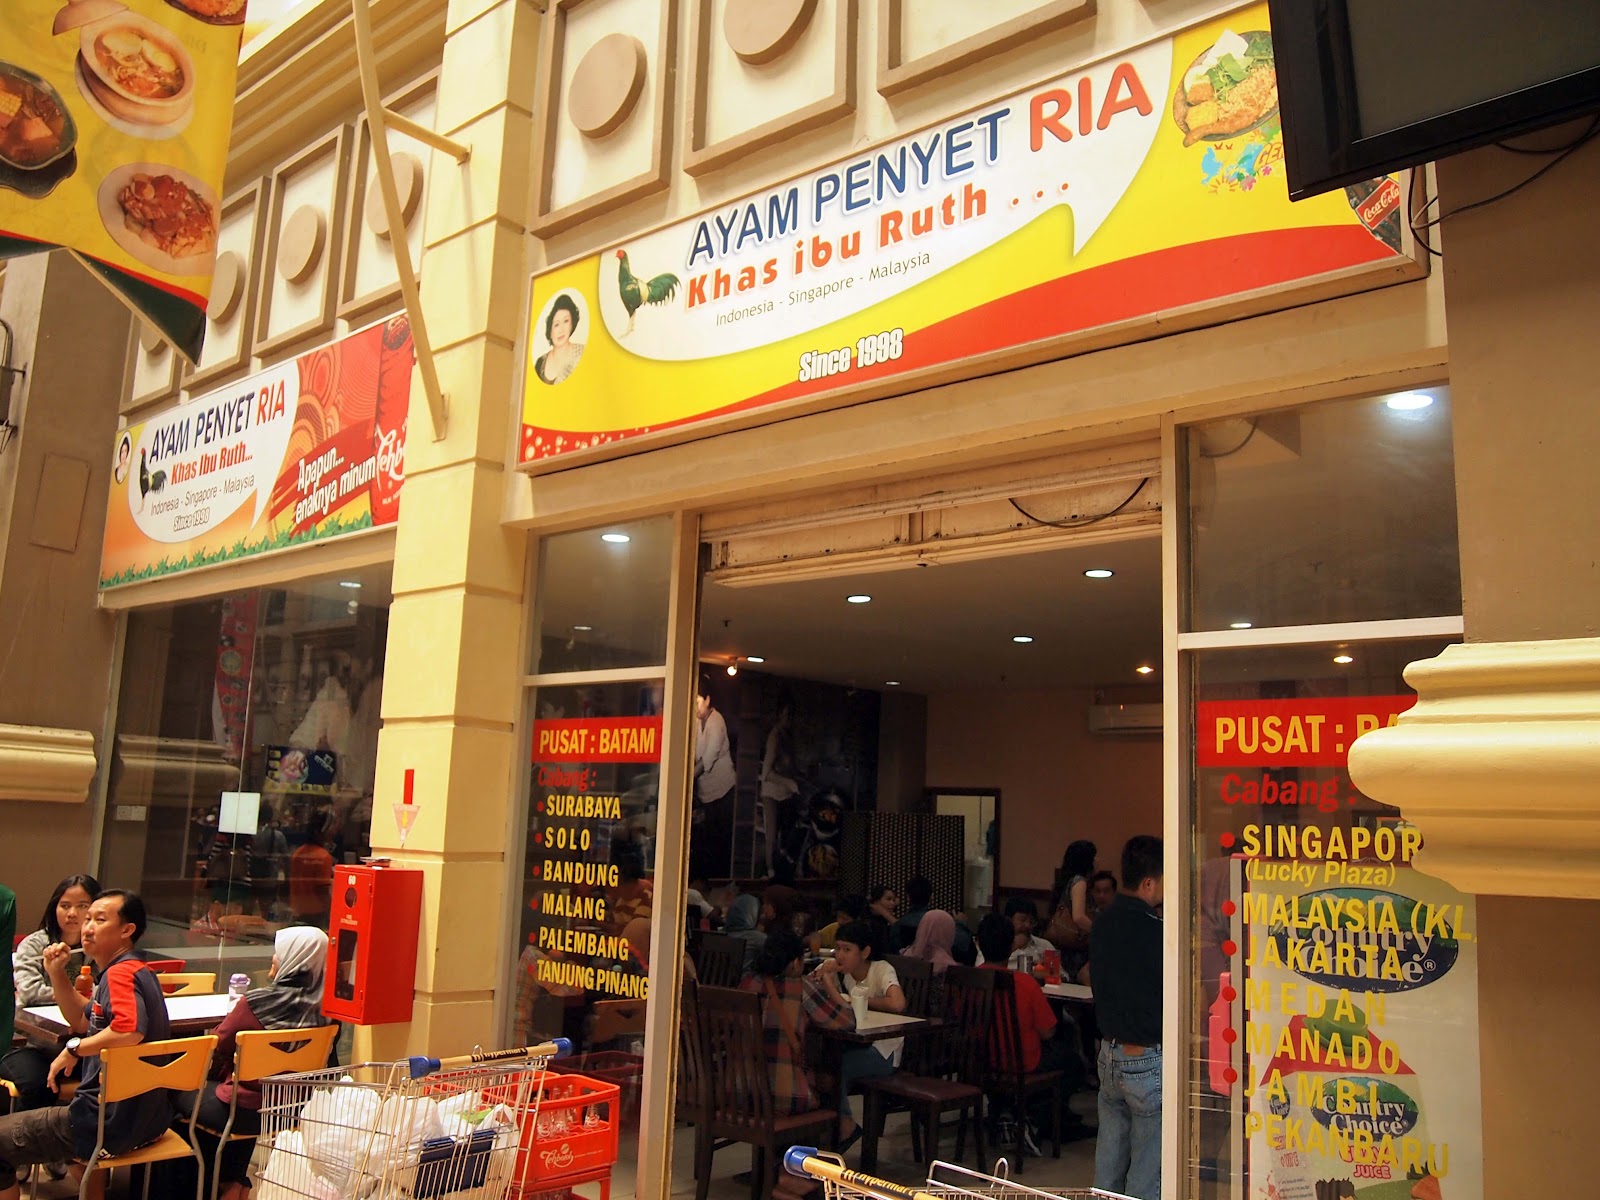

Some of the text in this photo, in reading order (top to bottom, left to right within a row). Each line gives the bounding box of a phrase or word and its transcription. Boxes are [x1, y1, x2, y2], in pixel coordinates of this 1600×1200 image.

[688, 61, 1153, 266] AYAM PENYET RIA
[1253, 142, 1284, 171] GE
[687, 257, 778, 309] Khas
[793, 229, 861, 276] ibu
[879, 182, 988, 248] Ruth
[715, 298, 775, 327] Indonesia
[787, 275, 854, 306] Singapore
[868, 251, 931, 280] Malaysia
[798, 327, 904, 382] Since 1998
[149, 379, 285, 465] AYAM PENYET RIA
[171, 459, 197, 485] Khas
[199, 452, 218, 476] Ibu
[151, 496, 179, 516] Indonesia
[184, 488, 218, 508] Singapore
[223, 474, 255, 495] Malaysia
[295, 456, 376, 525] enaknya minum
[174, 512, 192, 532] Since
[540, 729, 588, 754] PUSAT
[599, 728, 655, 754] BATAM
[1215, 715, 1326, 754] PUSAT
[537, 766, 589, 792] Cabang
[1220, 773, 1340, 813] Cabang
[546, 794, 621, 819] SURABAYA
[544, 826, 591, 851] SOLO
[543, 860, 619, 887] BANDUNG
[1244, 860, 1396, 887] (Lucky Plaza)
[542, 893, 606, 921] MALANG
[1242, 892, 1401, 935] MALAYSIA
[538, 926, 629, 961] PALEMBANG
[1245, 935, 1404, 981] JAKARTA
[537, 960, 649, 1000] TANJUNG PINANG
[1245, 978, 1386, 1027] MEDAN
[1245, 1020, 1401, 1075] MANADO
[1244, 1065, 1377, 1119] JAMBI
[1245, 1110, 1449, 1179] PEKANBARU
[1353, 1164, 1391, 1179] JUICE
